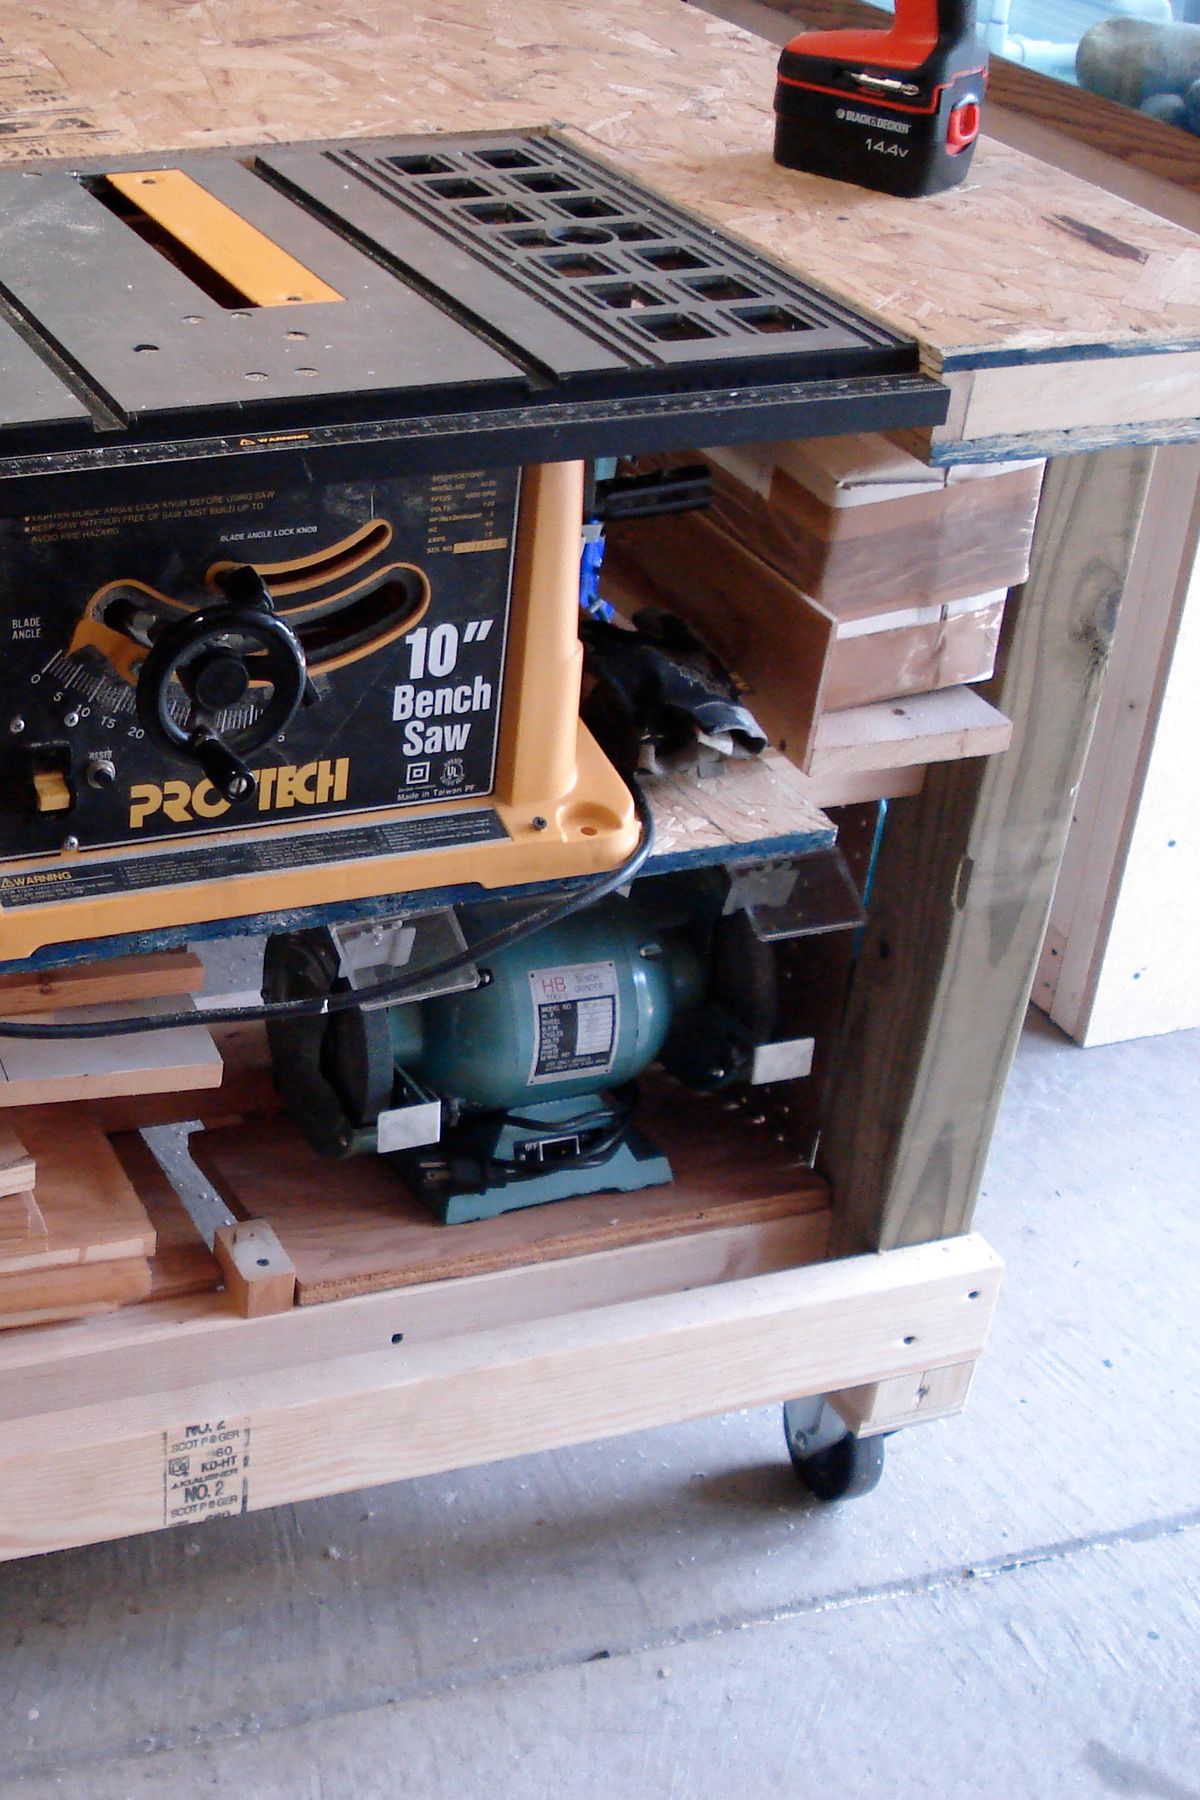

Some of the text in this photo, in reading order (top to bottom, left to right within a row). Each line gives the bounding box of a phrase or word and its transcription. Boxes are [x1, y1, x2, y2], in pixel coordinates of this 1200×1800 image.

[220, 533, 245, 542] BLADE
[247, 530, 272, 539] ANGLE
[274, 527, 294, 536] LOCK
[12, 617, 41, 629] BLADE
[12, 628, 41, 640] ANGLE
[53, 691, 64, 702] 5
[392, 675, 492, 722] Bench
[75, 704, 91, 718] 10
[101, 715, 116, 729] 15
[127, 726, 145, 739] 20
[402, 720, 472, 757] Saw
[397, 792, 419, 801] Made
[433, 786, 462, 796] Taiwan
[13, 871, 72, 887] WARNING
[541, 976, 566, 994] HB
[171, 1439, 199, 1454] SCOT
[201, 1455, 238, 1473] KD-HT
[185, 1480, 225, 1504] NO. 2
[171, 1504, 198, 1519] SCOT
